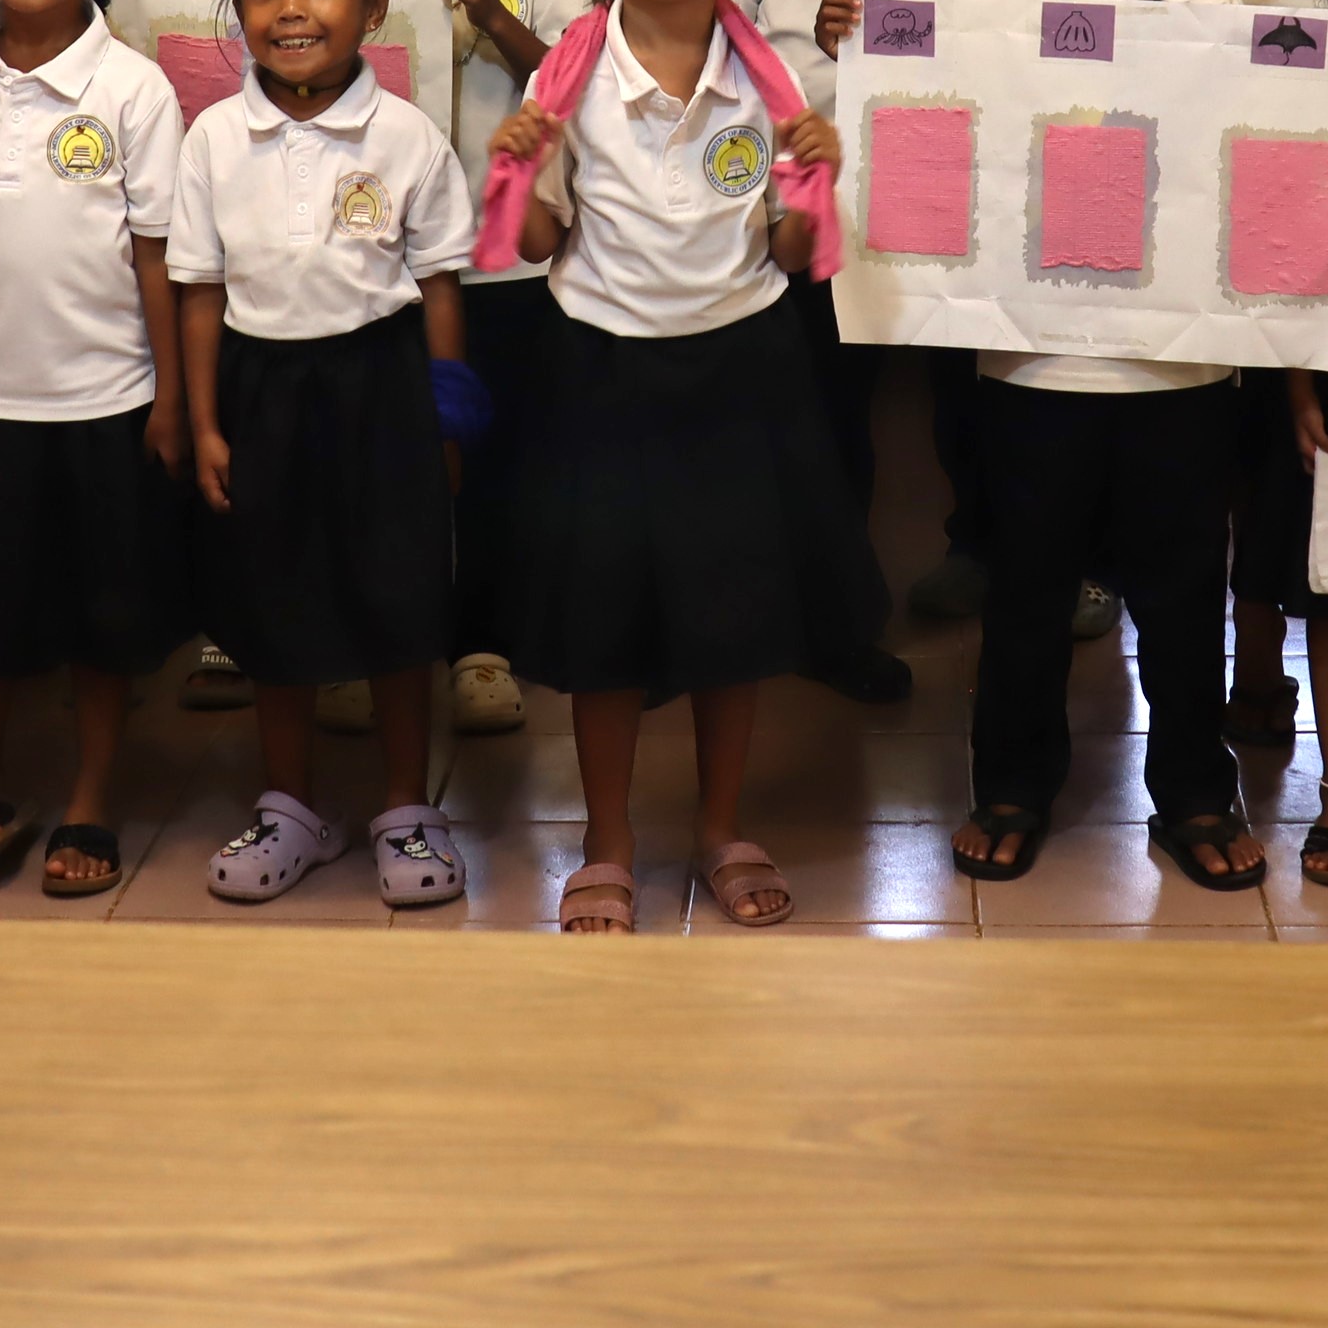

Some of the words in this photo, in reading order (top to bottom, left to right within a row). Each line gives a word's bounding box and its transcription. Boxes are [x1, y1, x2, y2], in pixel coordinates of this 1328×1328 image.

[85, 120, 111, 153] EDUCATION
[707, 133, 727, 165] MINISTRY
[739, 129, 765, 154] EDUCATION
[711, 175, 738, 193] REPUBLIC
[748, 166, 765, 186] PALAU
